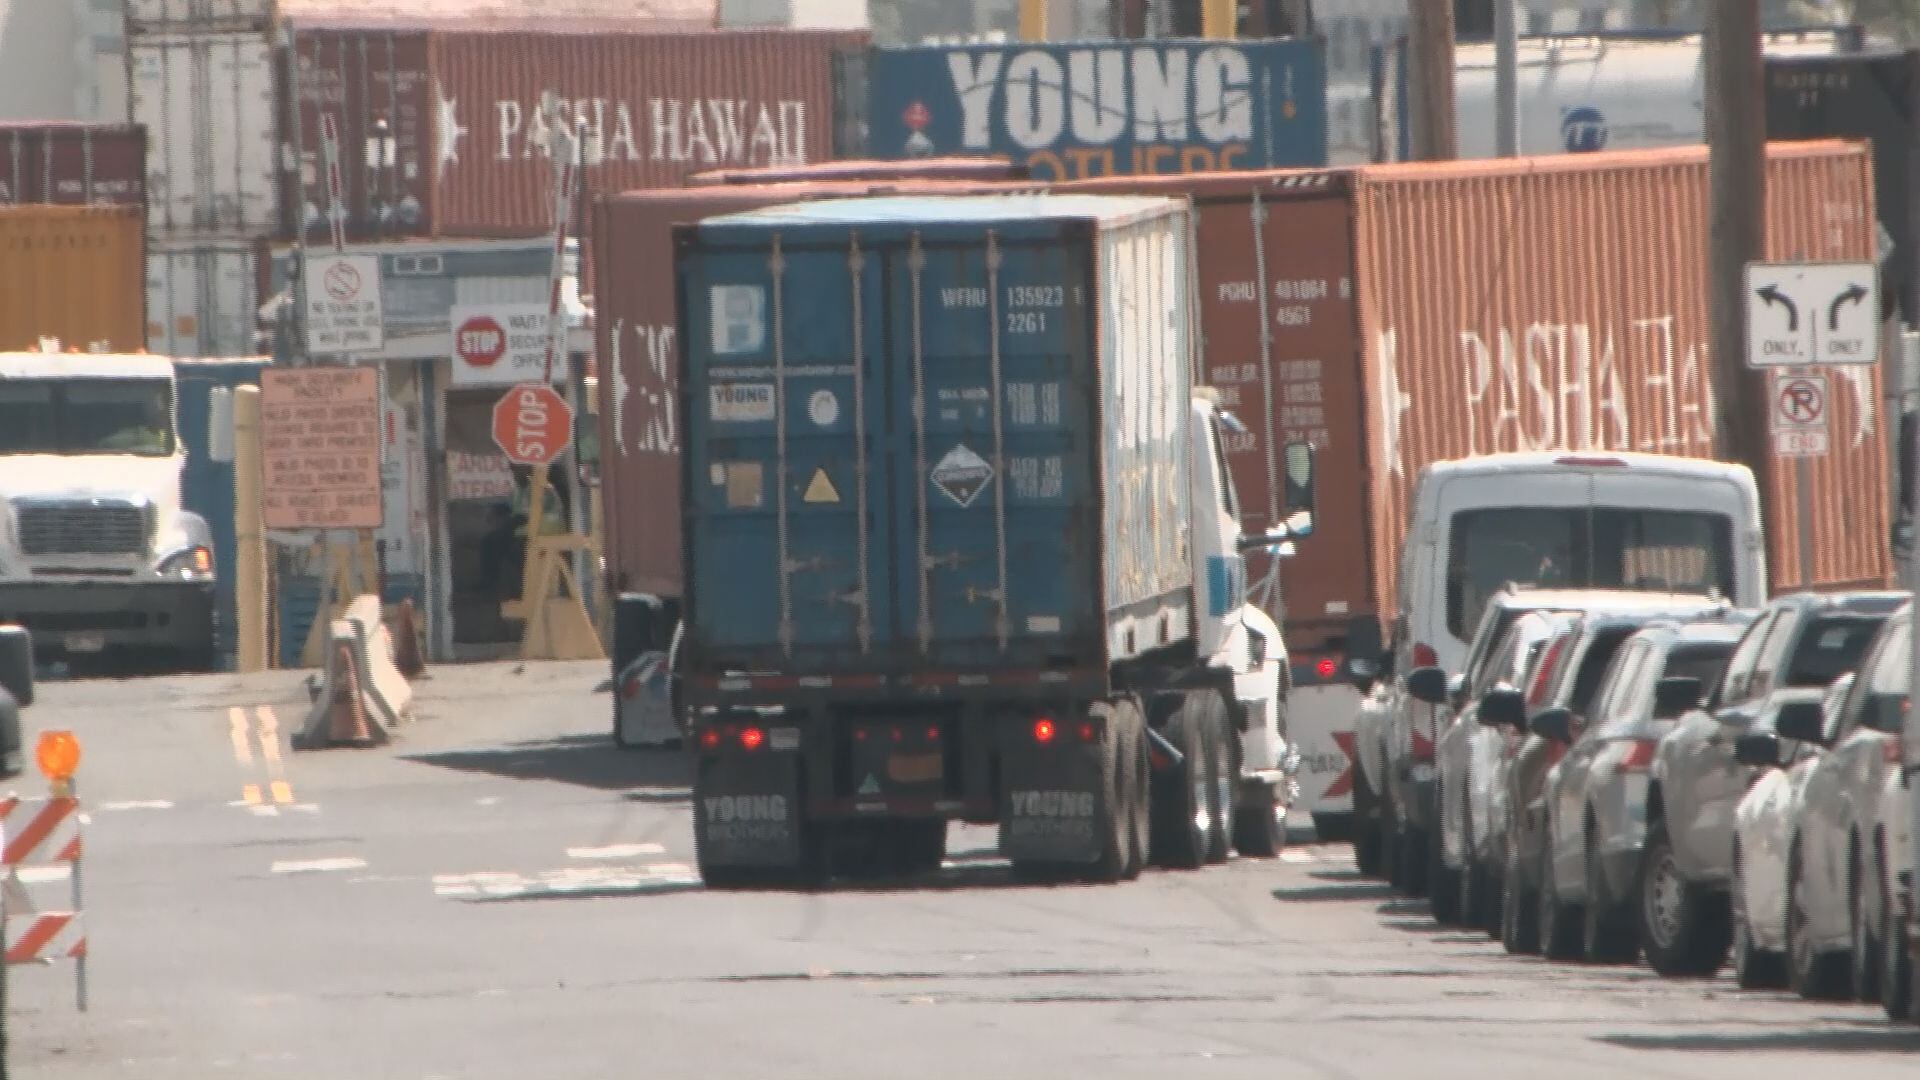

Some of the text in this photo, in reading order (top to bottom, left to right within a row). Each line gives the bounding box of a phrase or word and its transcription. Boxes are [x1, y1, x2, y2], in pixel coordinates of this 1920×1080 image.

[946, 46, 1254, 149] YOUNG
[647, 96, 806, 166] HAWAII
[1007, 286, 1064, 307] 135923
[461, 331, 500, 356] STOP
[509, 335, 565, 350] SECURY
[1763, 339, 1798, 355] ONLY
[1828, 338, 1864, 354] ONLY
[511, 353, 561, 369] OFFICR
[714, 386, 769, 403] YOUNG
[1460, 321, 1631, 458] PASHA
[517, 389, 549, 460] STOP
[704, 795, 787, 822] YOUNG
[1011, 790, 1095, 816] YOUNG
